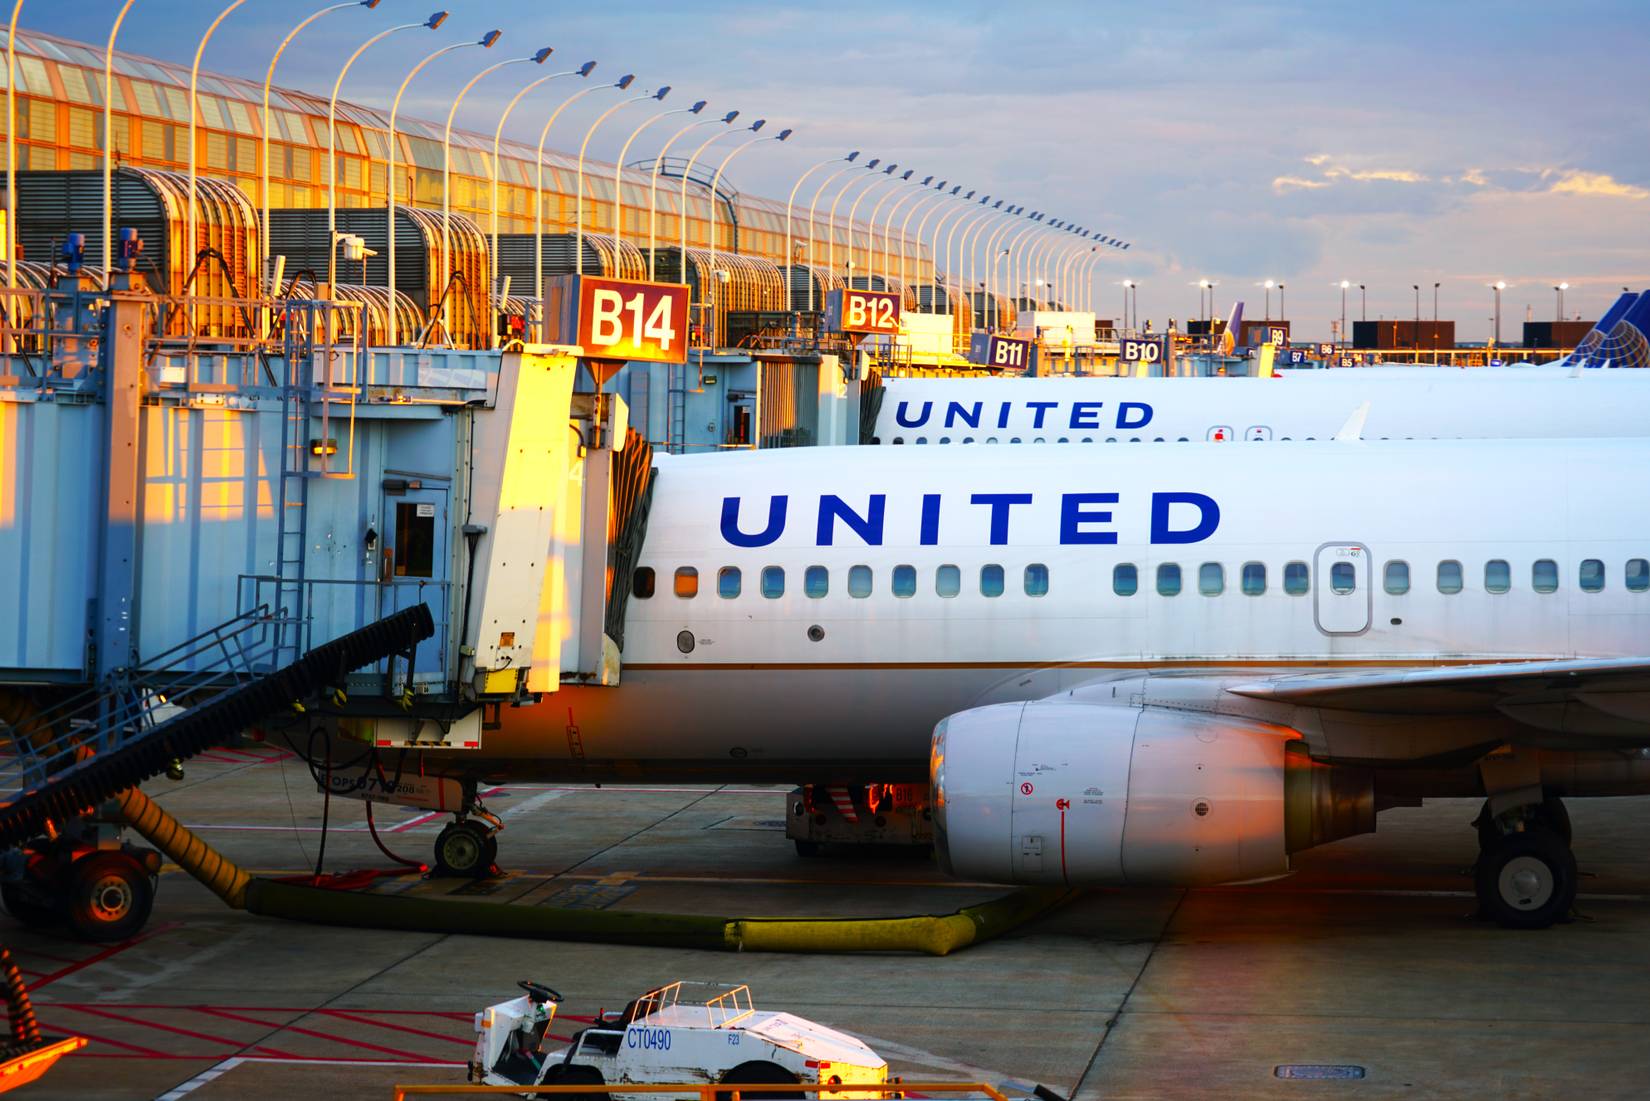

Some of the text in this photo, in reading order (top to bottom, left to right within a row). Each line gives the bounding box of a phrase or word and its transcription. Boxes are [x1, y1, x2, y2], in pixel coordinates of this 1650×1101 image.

[591, 288, 676, 350] B14
[849, 295, 894, 329] B12
[1271, 329, 1284, 346] B9
[995, 341, 1024, 366] B11
[1125, 341, 1159, 362] B10
[1292, 352, 1302, 363] B7
[1321, 344, 1333, 354] B6
[1341, 358, 1353, 367] B5
[895, 401, 1154, 429] UNITED
[719, 492, 1221, 548] UNITED
[627, 1028, 740, 1050] CT0490 F23
